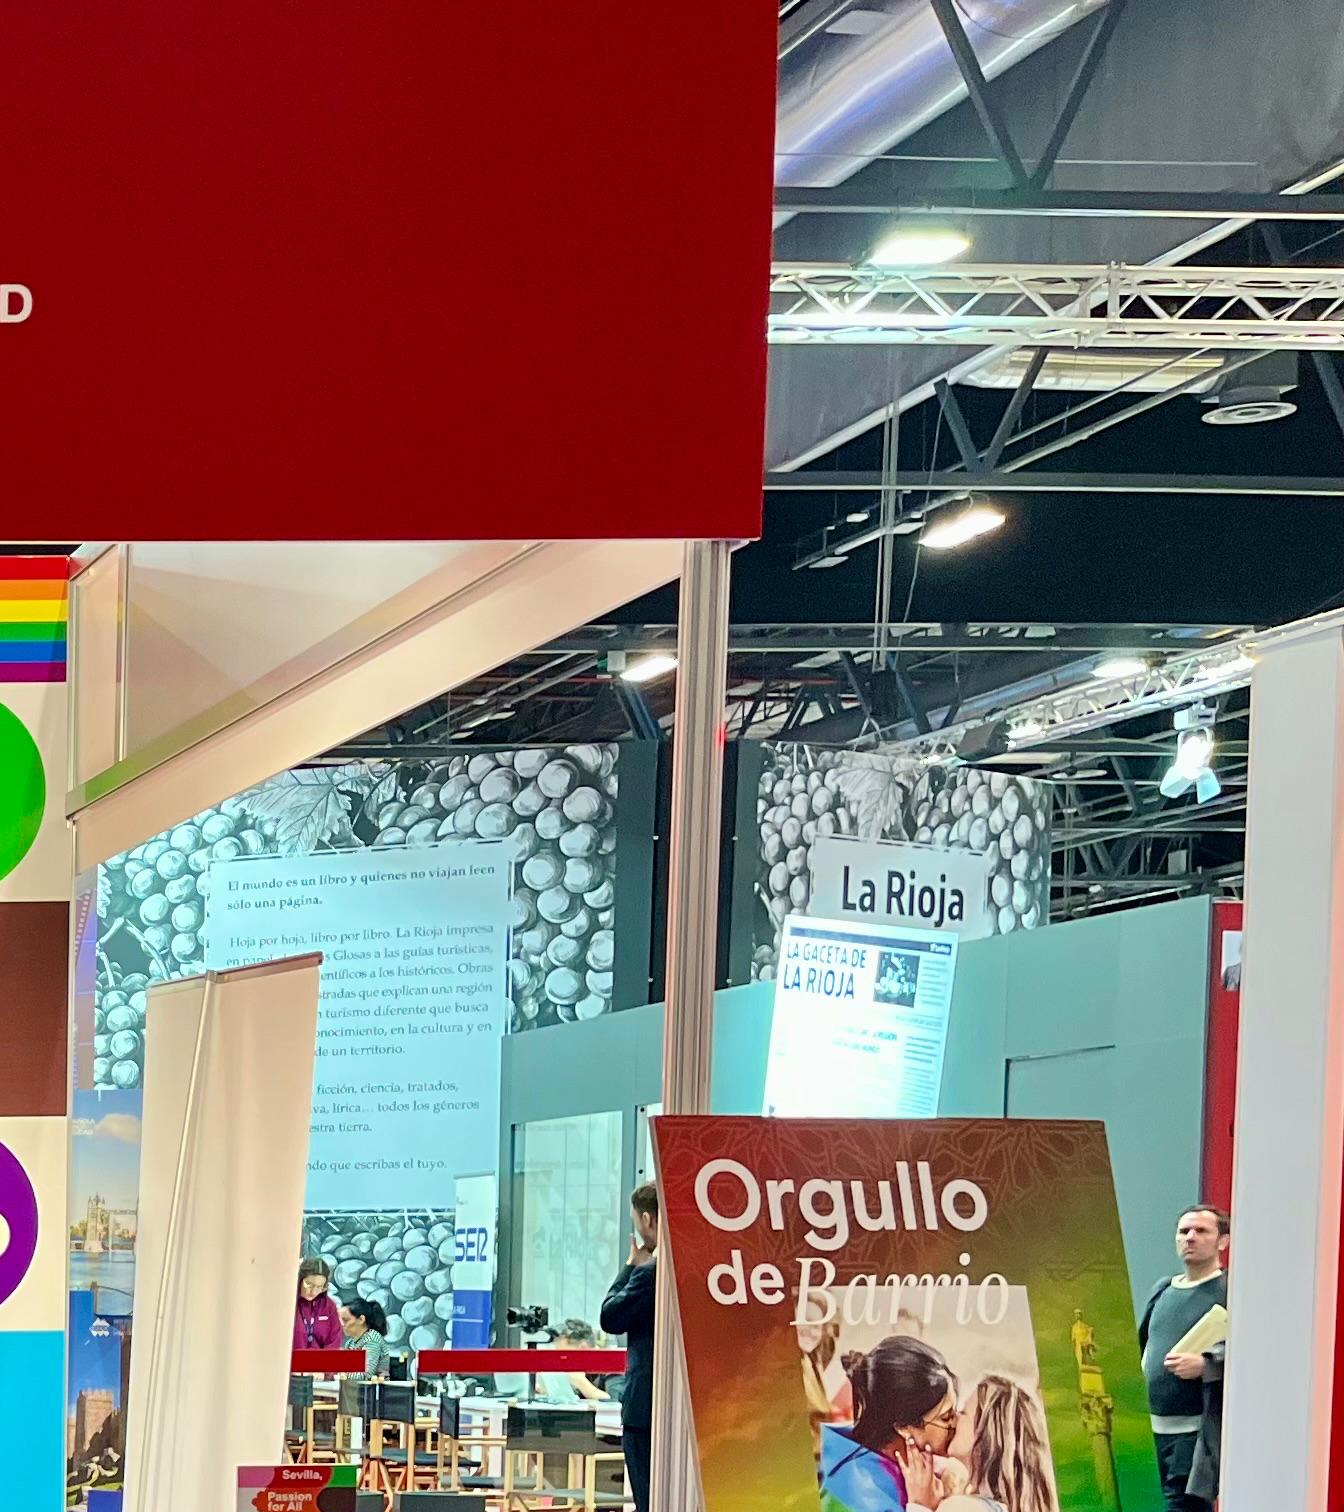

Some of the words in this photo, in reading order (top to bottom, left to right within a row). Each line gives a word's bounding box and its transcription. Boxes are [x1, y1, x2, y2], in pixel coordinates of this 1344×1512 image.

[228, 881, 238, 891] El
[243, 878, 283, 890] mundo
[301, 878, 316, 886] un
[319, 874, 347, 885] libro
[350, 875, 357, 886] y
[360, 872, 407, 885] quienes
[410, 871, 426, 879] no
[429, 866, 466, 881] viajan
[470, 864, 495, 875] leen
[227, 900, 251, 910] sólo
[255, 901, 276, 909] una
[279, 895, 323, 910] página.
[842, 865, 875, 913] La
[886, 870, 963, 927] Rioja
[230, 937, 256, 949] Hoja
[259, 937, 278, 948] por
[281, 934, 307, 946] hoja,
[311, 932, 337, 943] libro
[340, 931, 360, 944] por
[363, 929, 392, 940] libro.
[396, 927, 410, 938] La
[414, 926, 443, 939] Rioja
[446, 925, 494, 937] impresa
[333, 950, 372, 961] Glosas
[374, 951, 381, 959] a
[384, 947, 400, 958] las
[403, 946, 434, 960] guías
[787, 943, 799, 958] LA
[803, 944, 847, 965] GACETA
[851, 949, 867, 968] DE
[226, 958, 239, 966] en
[320, 968, 367, 981] entíficos
[379, 967, 395, 977] los
[458, 962, 493, 974] Obras
[784, 965, 801, 990] LA
[806, 968, 854, 999] RIOJA
[358, 989, 379, 1001] que
[381, 984, 429, 999] explican
[431, 985, 453, 994] una
[456, 982, 493, 996] región
[326, 1007, 371, 1019] turismo
[373, 1005, 426, 1017] diferente
[429, 1004, 451, 1016] que
[455, 1002, 489, 1013] busca
[315, 1025, 388, 1038] onocimiento,
[390, 1027, 405, 1035] en
[408, 1024, 419, 1034] la
[421, 1023, 462, 1034] cultura
[466, 1023, 474, 1034] y
[477, 1022, 492, 1031] en
[332, 1047, 347, 1056] un
[407, 1080, 459, 1093] tratados,
[377, 1101, 410, 1113] todos
[413, 1101, 430, 1111] los
[433, 1099, 480, 1113] géneros
[308, 1123, 335, 1133] estra
[330, 1161, 351, 1174] que
[354, 1158, 401, 1170] escribas
[403, 1158, 414, 1169] el
[417, 1159, 447, 1173] tuyo.
[694, 1158, 987, 1251] Orgullo
[707, 1249, 785, 1305] de
[790, 1253, 1009, 1326] Barrio
[282, 1470, 323, 1480] Sevilla,
[267, 1491, 312, 1502] Passion
[267, 1502, 284, 1512] for
[286, 1502, 303, 1511] All
